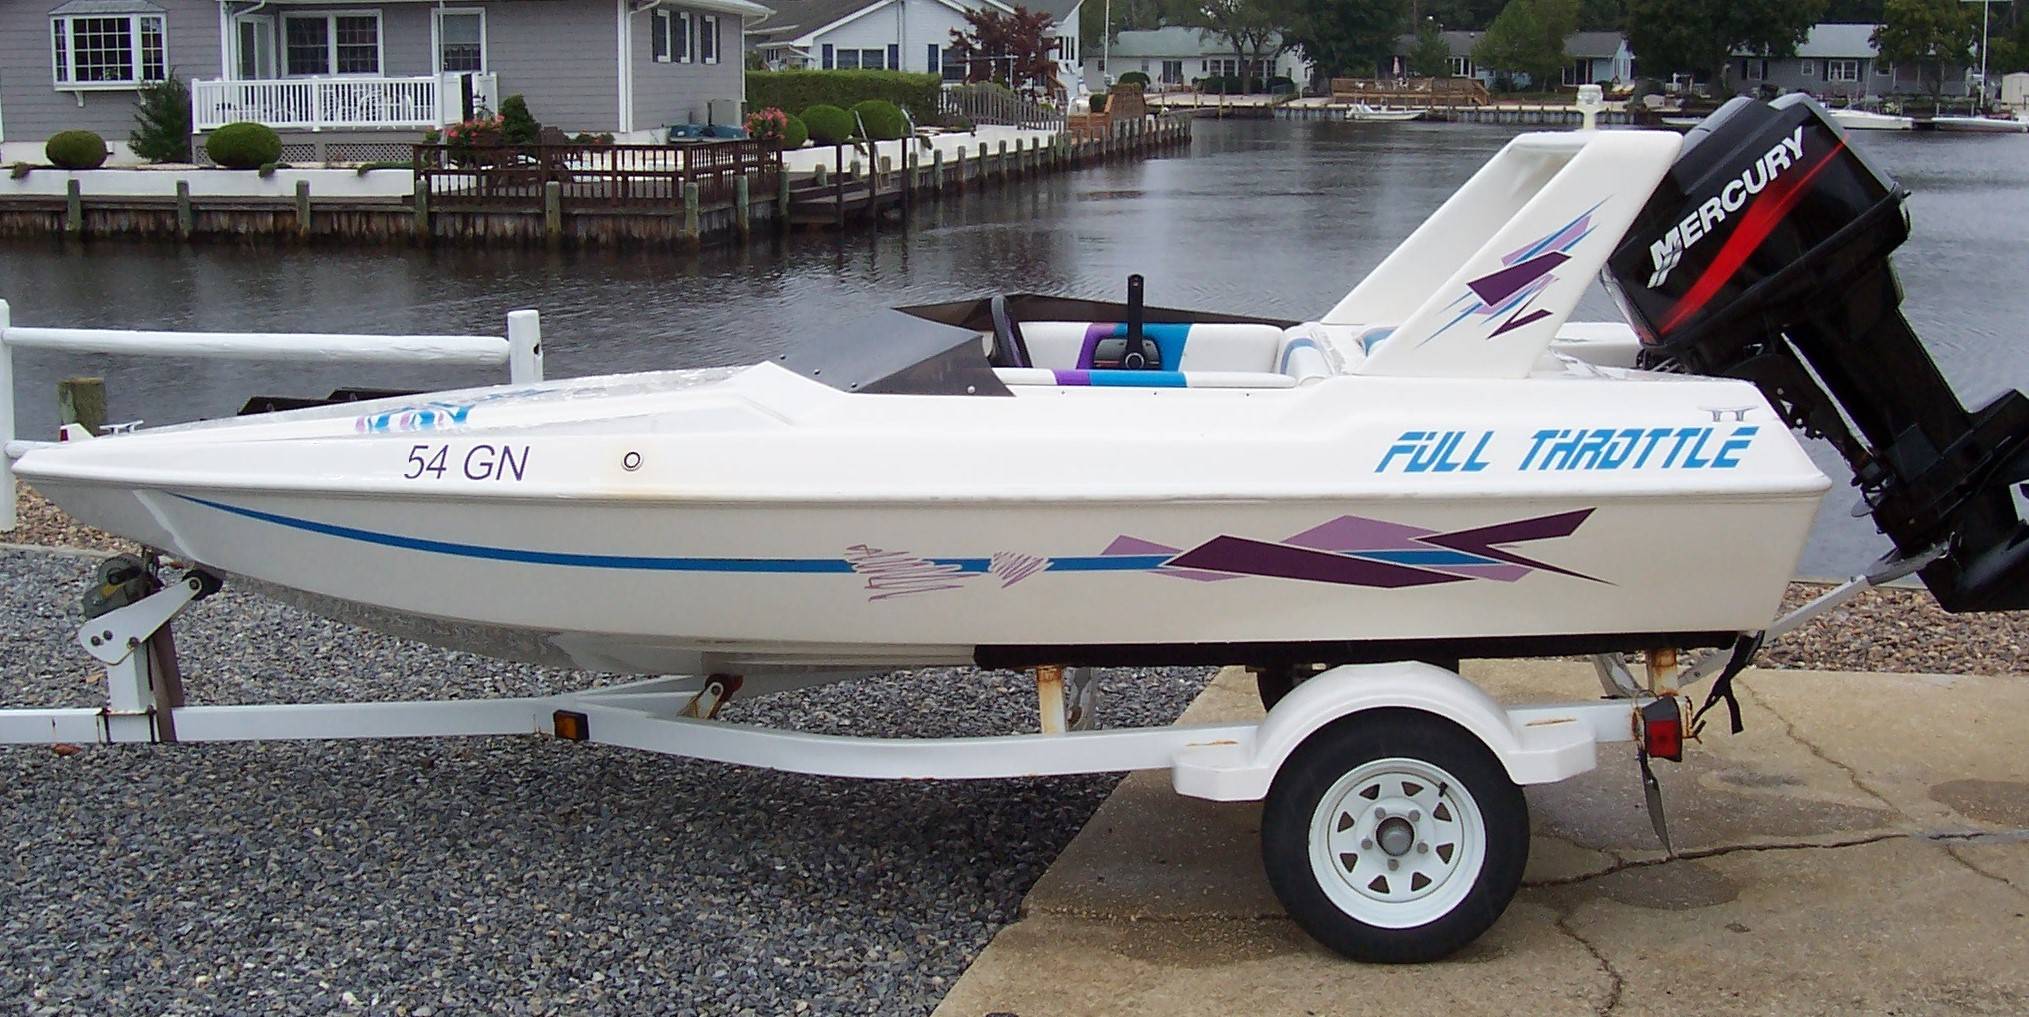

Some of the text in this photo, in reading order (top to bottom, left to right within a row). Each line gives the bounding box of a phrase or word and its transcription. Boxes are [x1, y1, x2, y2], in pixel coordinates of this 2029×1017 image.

[1648, 125, 1804, 281] MERCURY
[403, 444, 530, 481] 54 GN
[1374, 426, 1760, 473] FULL THROTTLE
